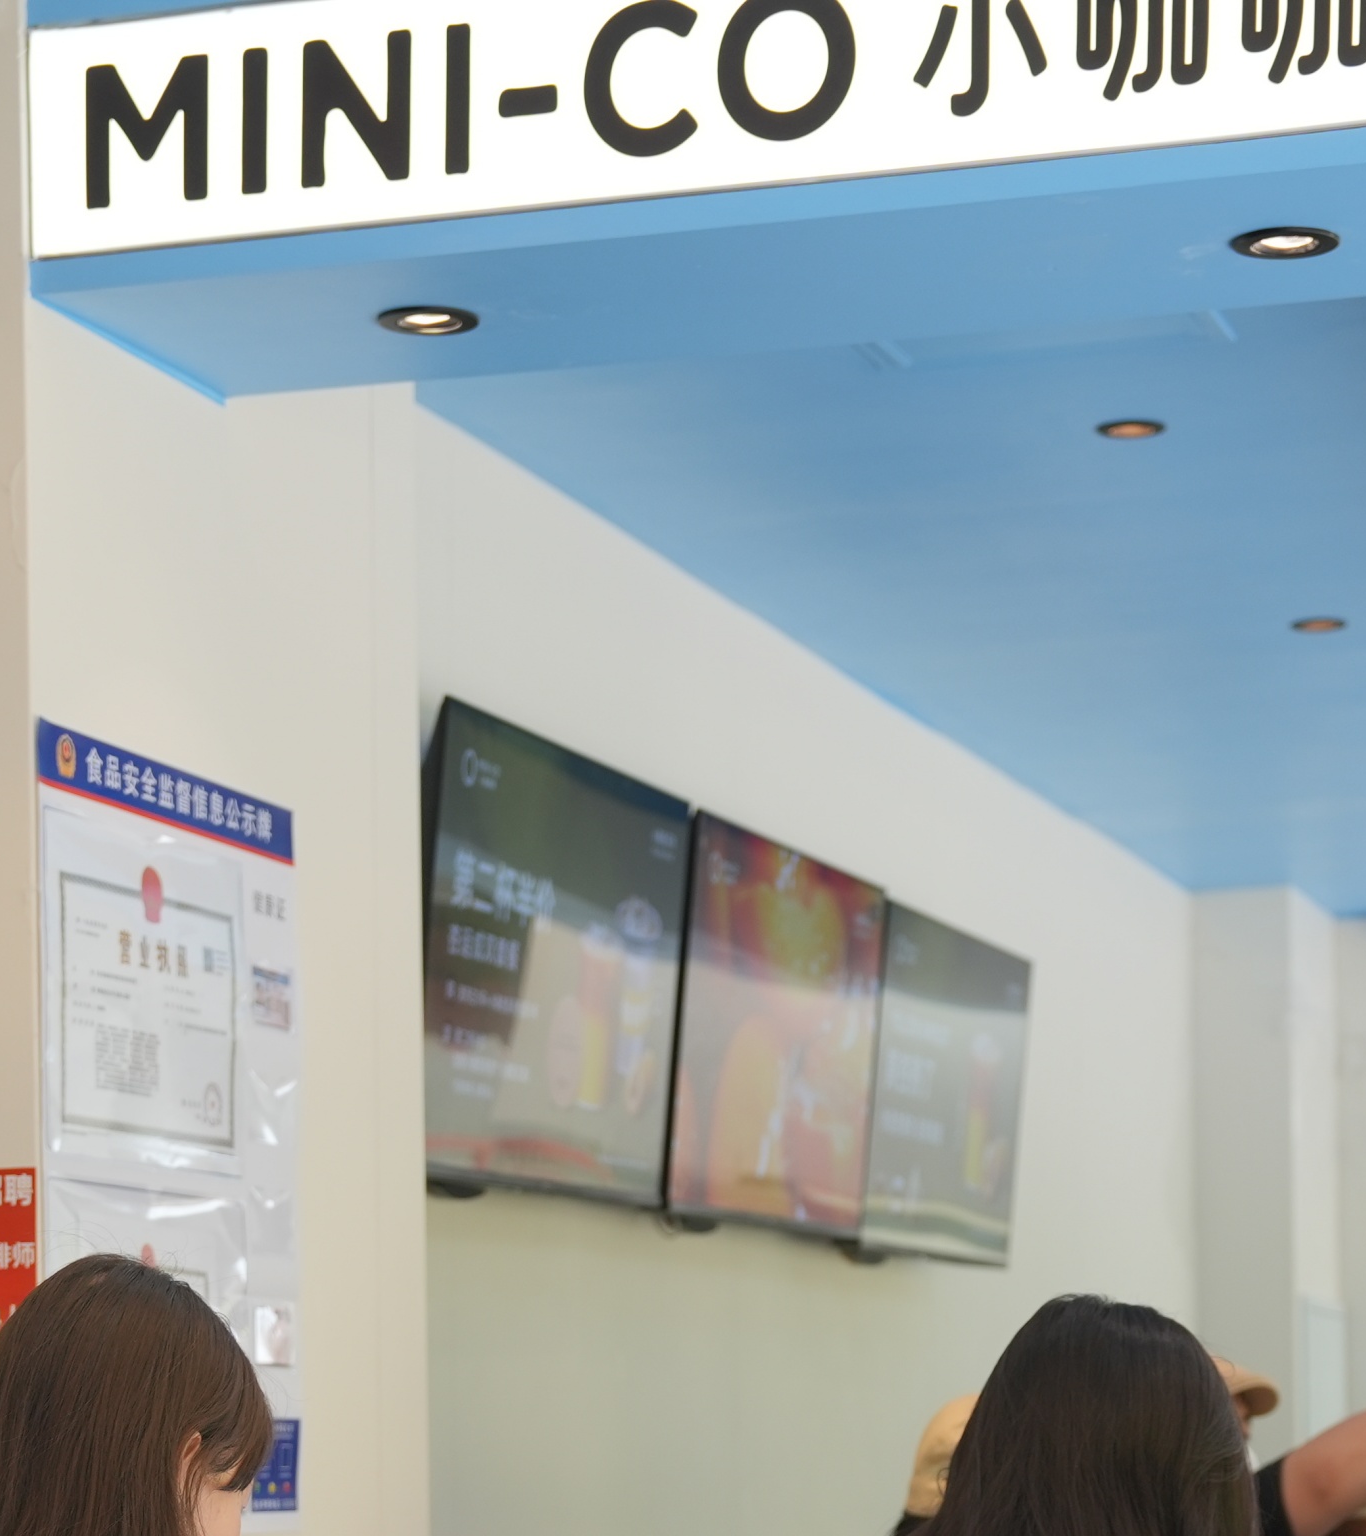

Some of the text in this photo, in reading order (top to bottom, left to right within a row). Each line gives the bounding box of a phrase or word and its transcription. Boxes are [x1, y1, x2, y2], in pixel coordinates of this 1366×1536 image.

[86, 0, 857, 210] MINI-CO
[85, 747, 272, 843] 食品安全监督信息公示牌
[119, 930, 189, 978] 营业执照
